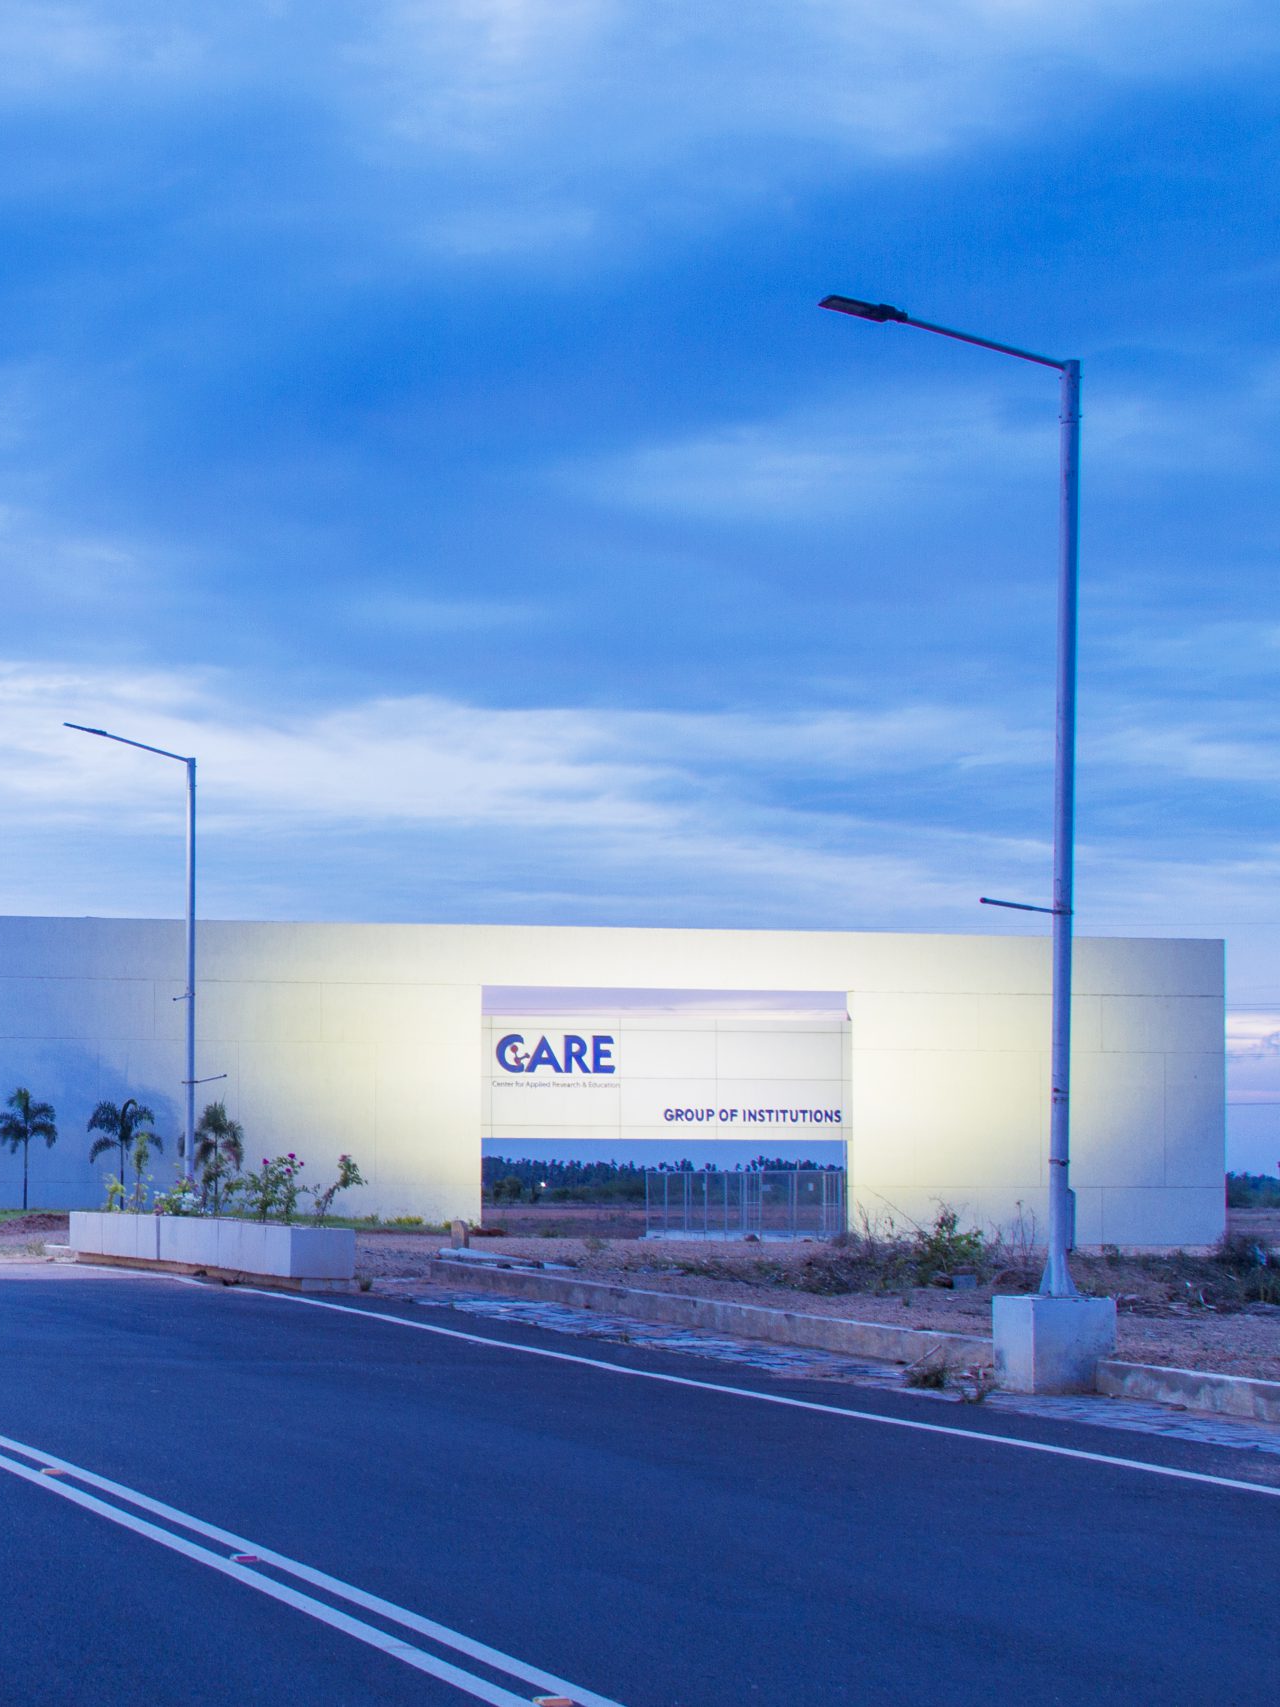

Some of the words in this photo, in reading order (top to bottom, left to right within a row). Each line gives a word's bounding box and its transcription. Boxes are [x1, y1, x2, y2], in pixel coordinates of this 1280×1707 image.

[496, 1034, 616, 1074] CARE
[492, 1080, 514, 1088] Center
[515, 1080, 524, 1088] for
[525, 1080, 551, 1089] Applied
[552, 1080, 580, 1089] Research
[588, 1081, 620, 1089] Education
[664, 1108, 715, 1122] GROUP
[719, 1108, 738, 1122] OF
[743, 1109, 842, 1123] INSTITUTIONS
